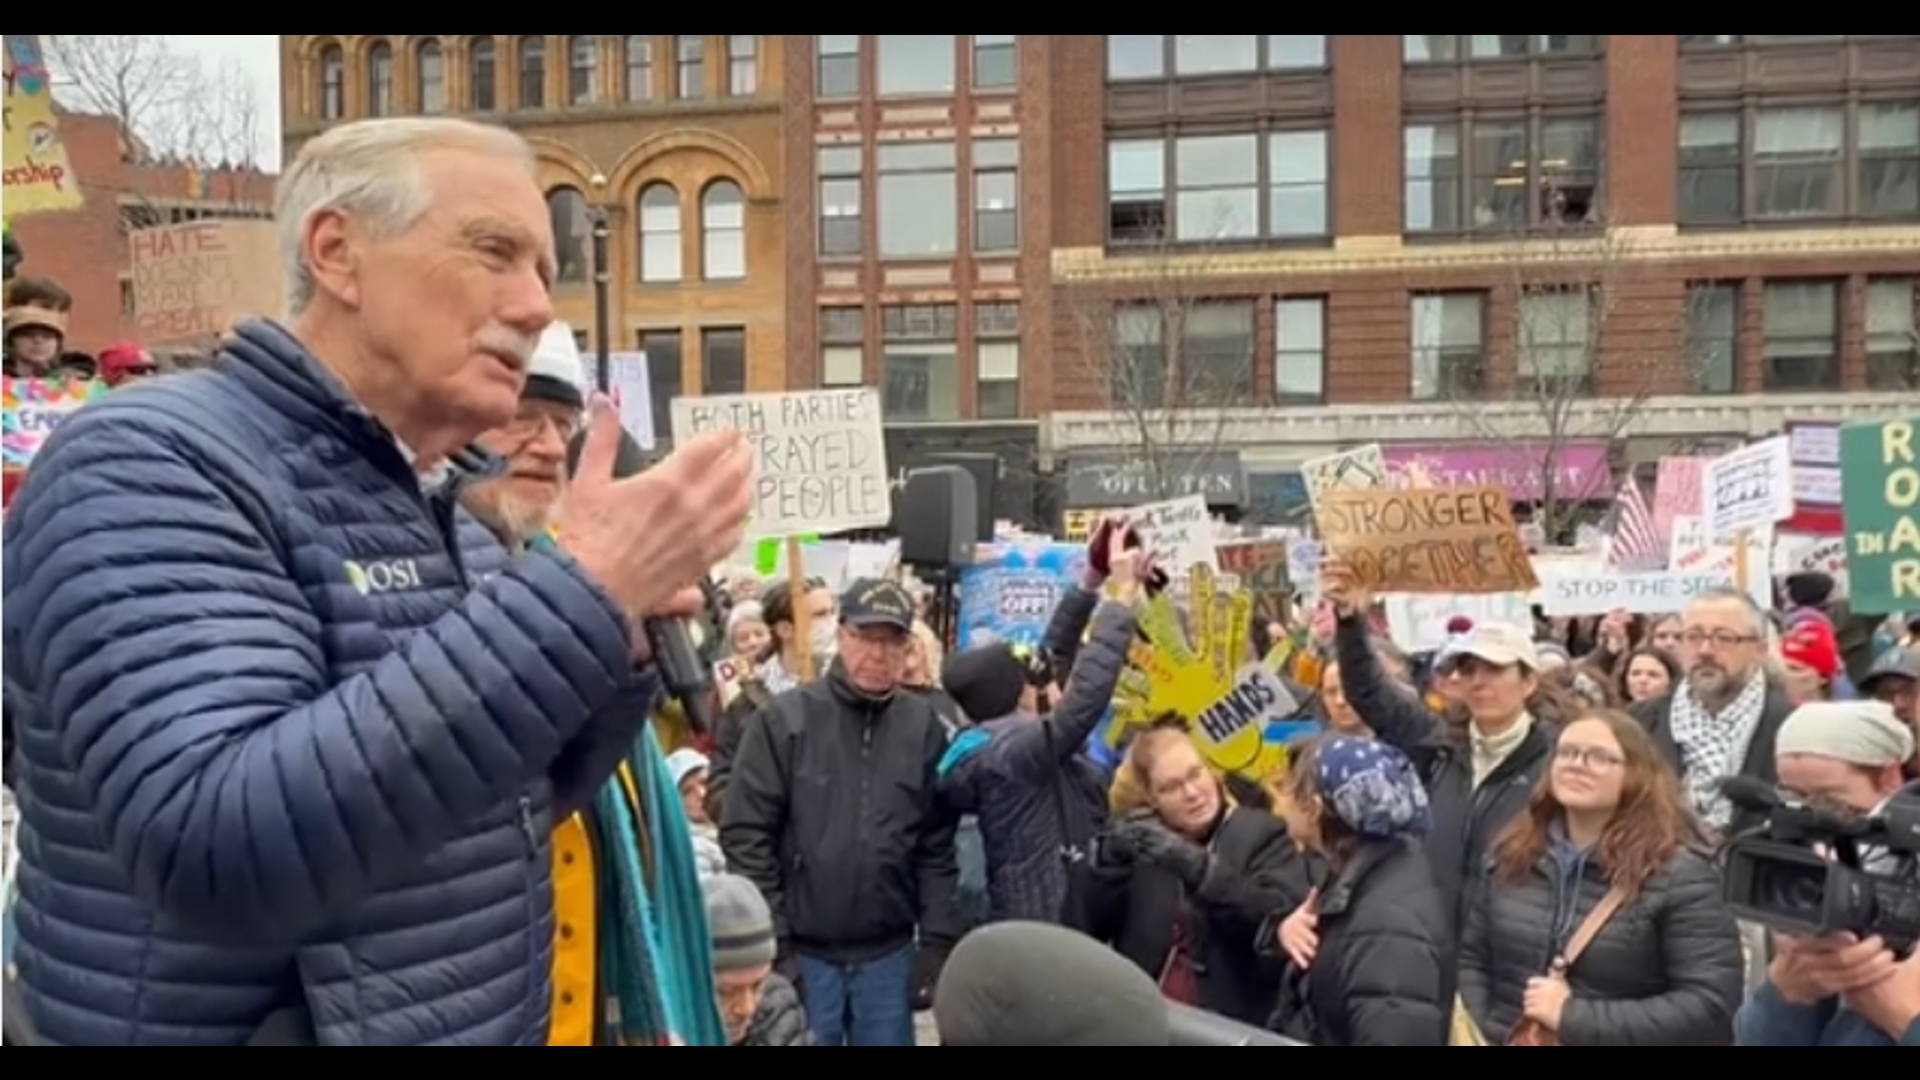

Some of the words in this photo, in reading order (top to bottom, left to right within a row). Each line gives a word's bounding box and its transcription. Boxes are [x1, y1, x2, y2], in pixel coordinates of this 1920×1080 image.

[134, 223, 228, 263] HATE
[751, 429, 872, 474] RAYED
[756, 473, 881, 521] PEOPLE
[1328, 491, 1507, 535] STRONGER
[1351, 531, 1540, 588] OGETHER
[1556, 578, 1618, 599] STOP
[1624, 577, 1675, 598] THE
[1198, 672, 1275, 743] HANDS
